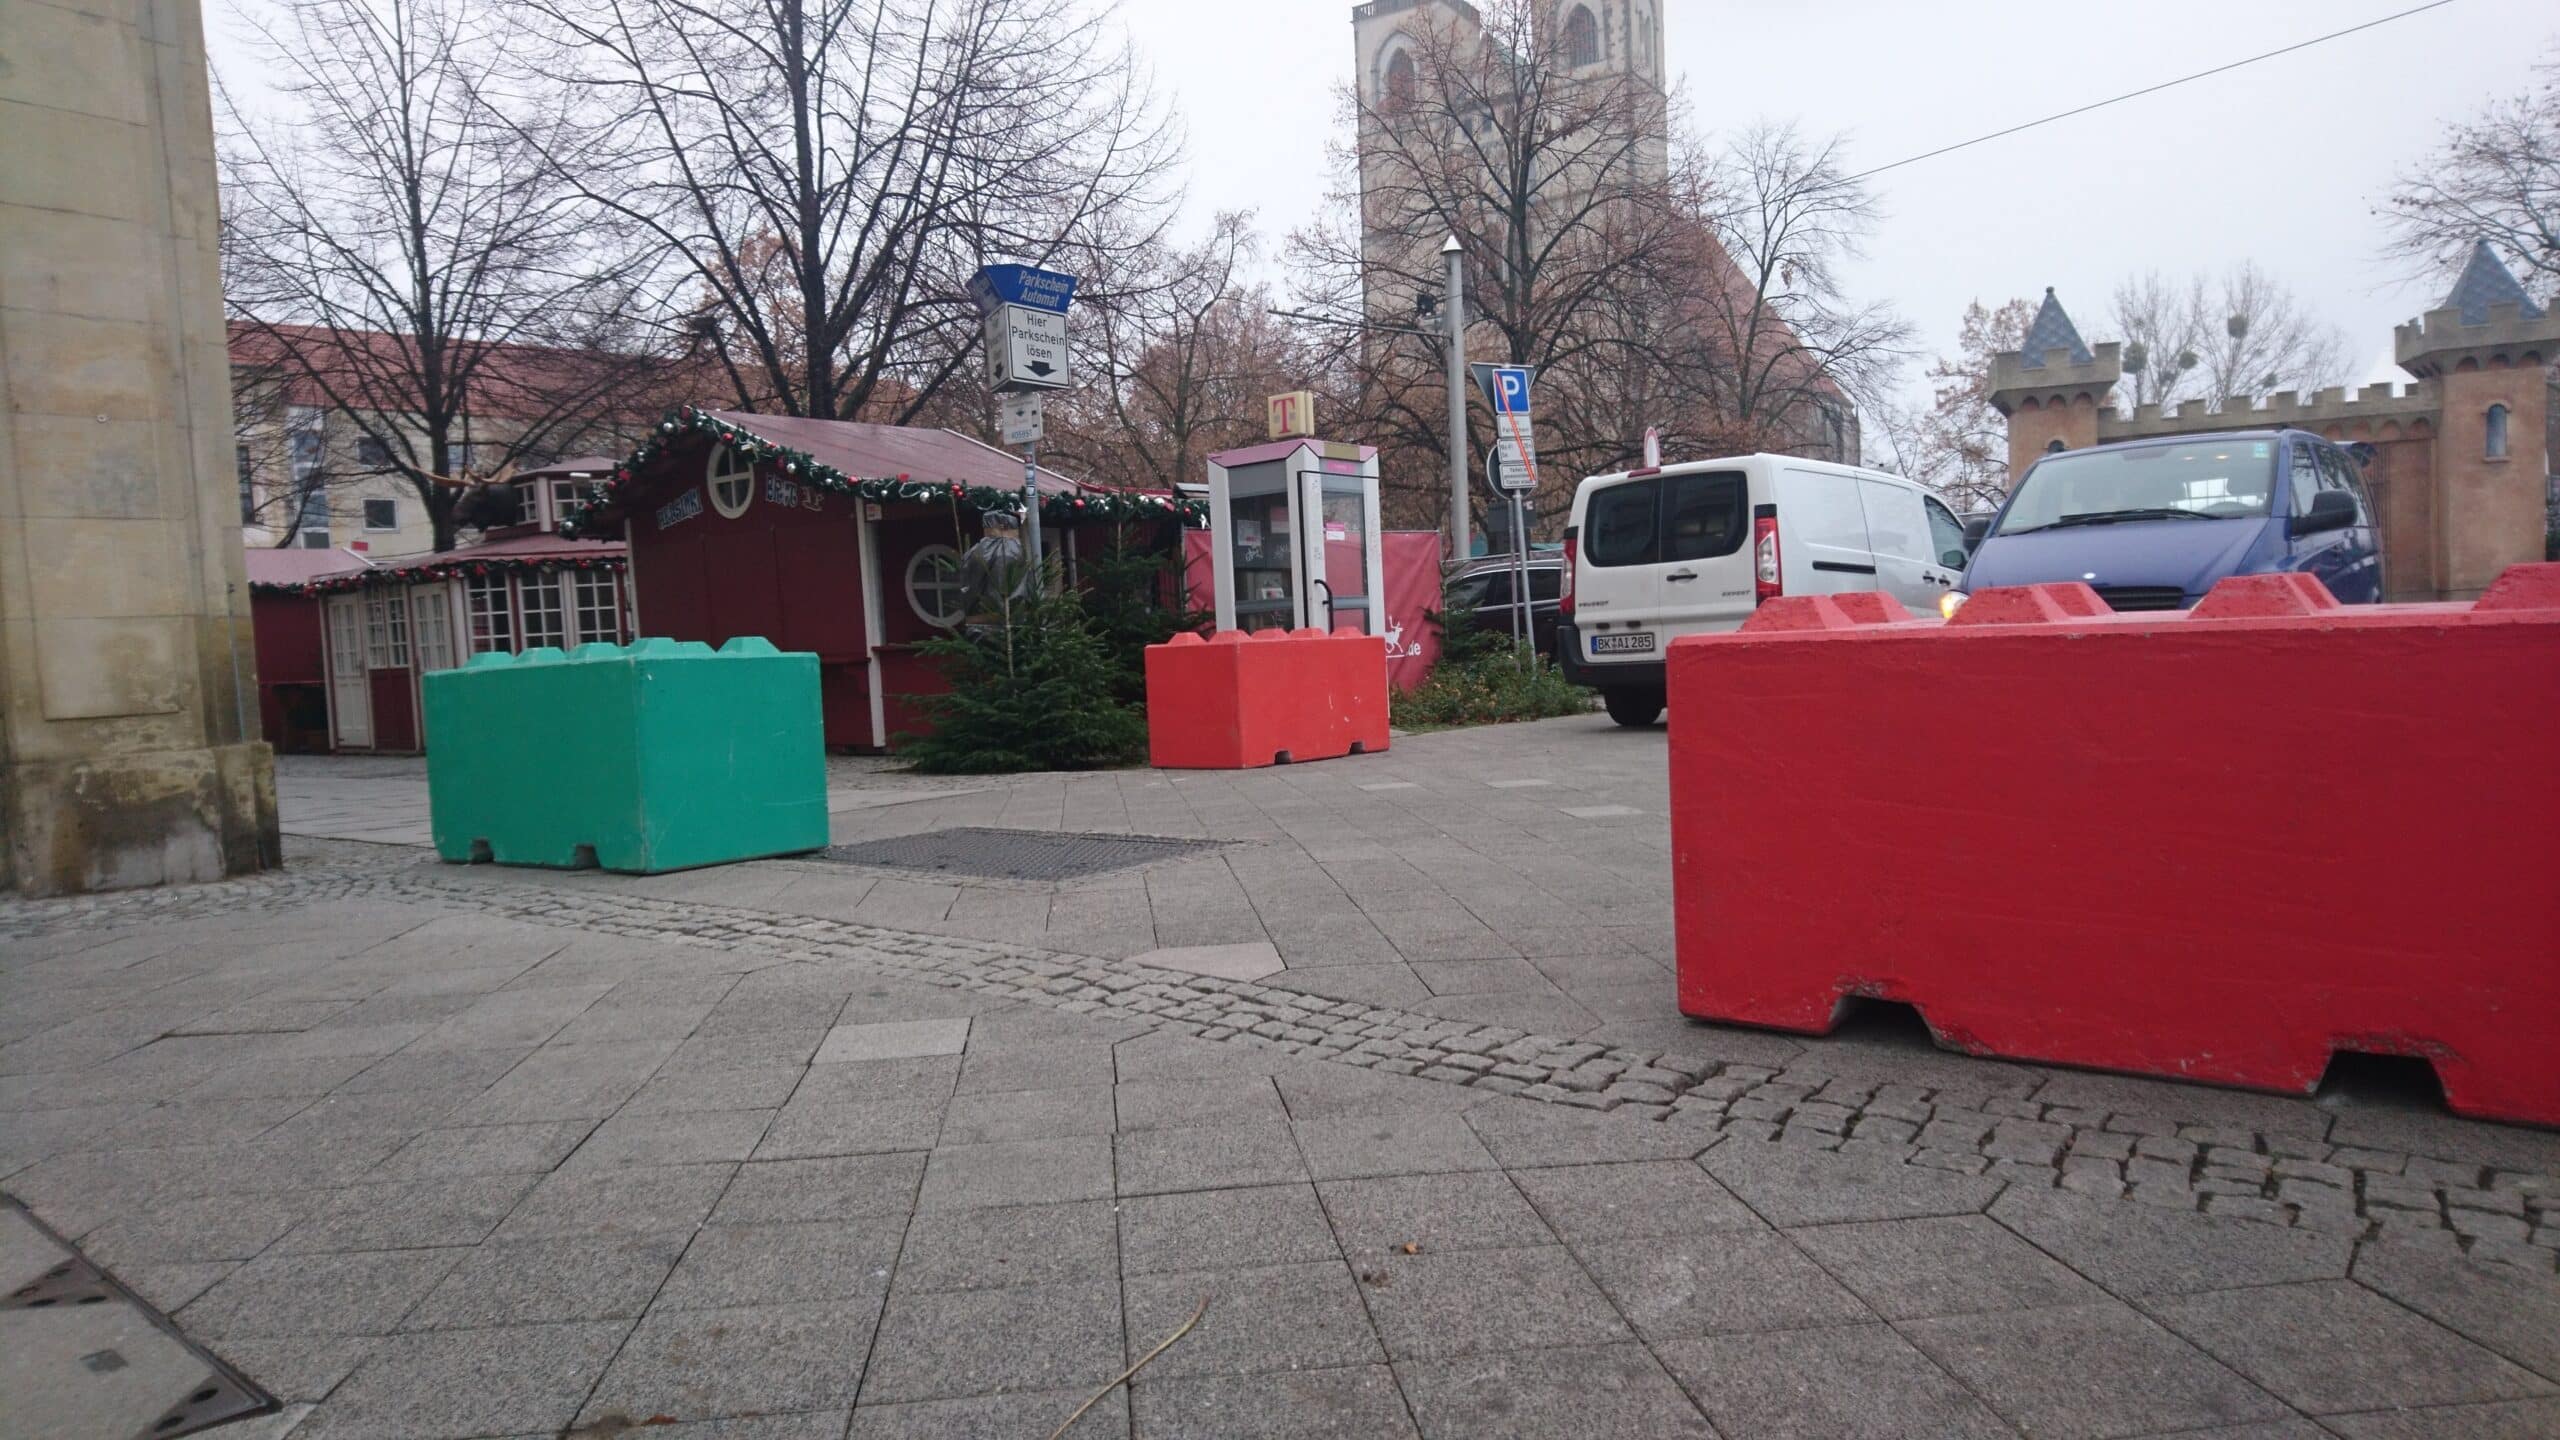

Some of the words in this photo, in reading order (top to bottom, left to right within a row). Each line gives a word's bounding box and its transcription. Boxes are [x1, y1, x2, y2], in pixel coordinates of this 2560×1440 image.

[1018, 270, 1069, 294] Parkschein
[1020, 288, 1060, 307] Automat
[1026, 313, 1048, 328] Hier
[1011, 325, 1065, 346] Parkschein
[1026, 343, 1053, 360] lösen
[1501, 375, 1520, 404] P
[1273, 397, 1296, 434] T
[1598, 637, 1611, 650] BK
[1631, 635, 1652, 648] 285
